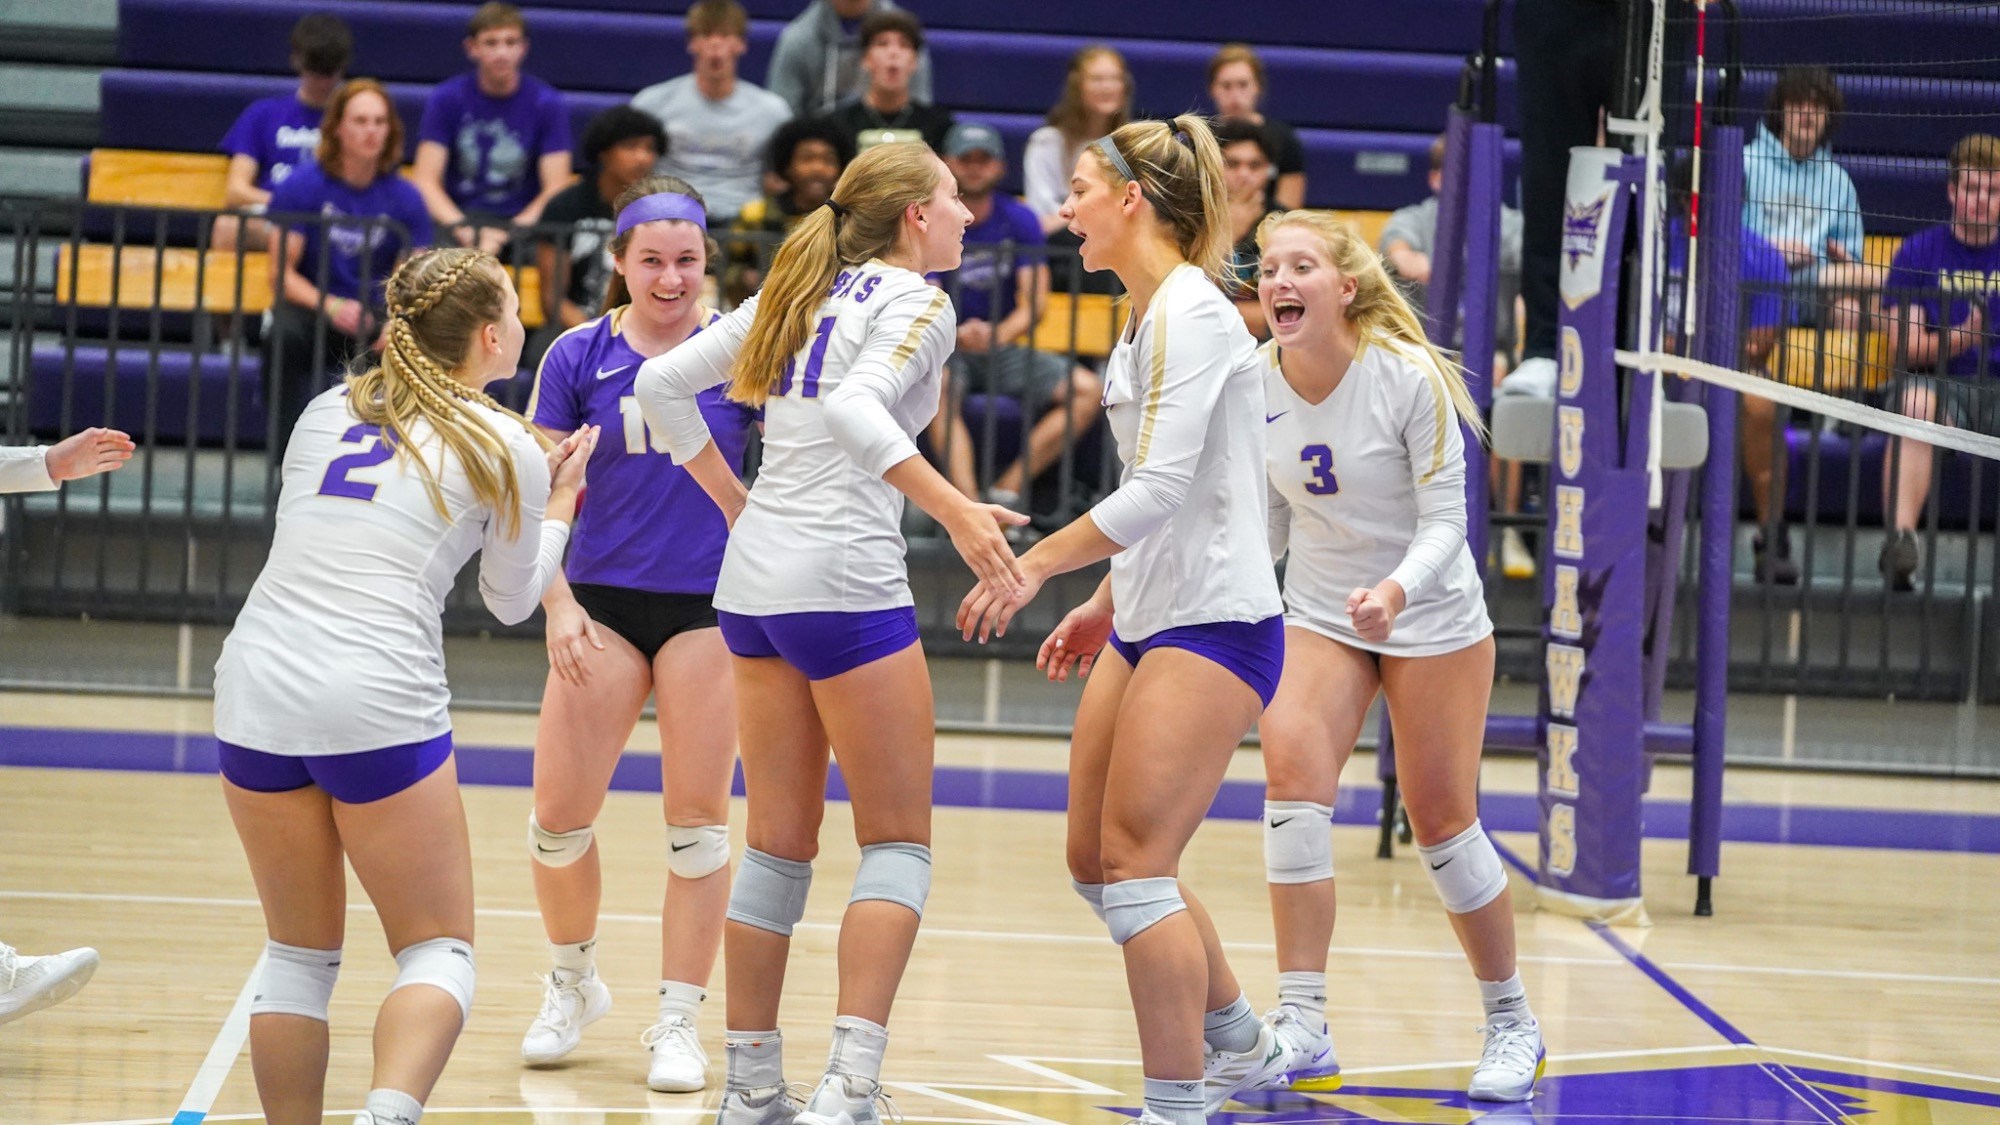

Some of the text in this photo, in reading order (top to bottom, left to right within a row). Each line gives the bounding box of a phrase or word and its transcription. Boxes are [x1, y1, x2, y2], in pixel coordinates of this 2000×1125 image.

[828, 270, 882, 303] RAS
[317, 420, 402, 502] 2
[1299, 443, 1340, 496] 3
[1546, 325, 1585, 878] DUHAWKS
